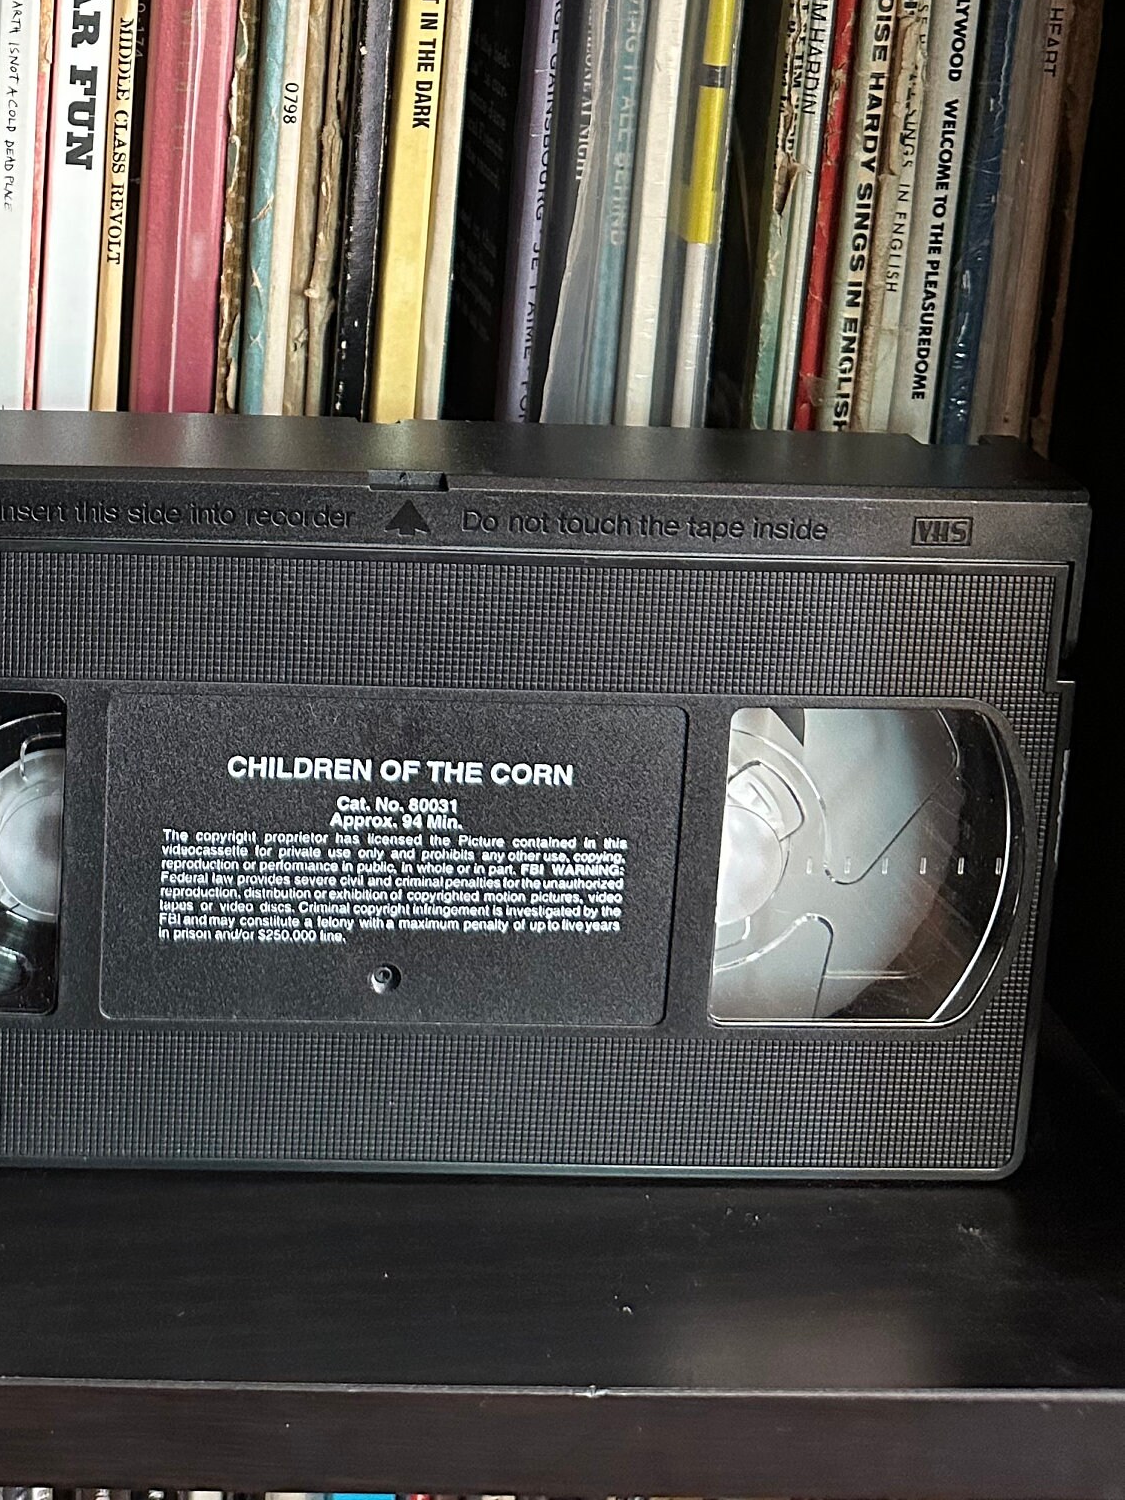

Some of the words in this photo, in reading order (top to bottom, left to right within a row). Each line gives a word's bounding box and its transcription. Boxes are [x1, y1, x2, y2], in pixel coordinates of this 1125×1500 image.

[420, 13, 439, 30] IN
[114, 18, 135, 100] MIDDLE
[417, 38, 436, 72] THE
[65, 65, 98, 170] FUN
[283, 83, 300, 124] 0798
[412, 80, 433, 128] DARK
[861, 72, 886, 172] HARDY
[110, 110, 129, 174] CLASS
[935, 100, 959, 191] WELCOME
[932, 195, 947, 218] TO
[107, 182, 125, 265] REVOLT
[849, 183, 873, 272] SINGS
[928, 222, 944, 255] THE
[846, 281, 863, 307] IN
[911, 260, 941, 400] PLEASUREDOME
[76, 503, 117, 524] this
[128, 503, 181, 525] side
[190, 503, 234, 525] into
[246, 504, 355, 528] recorder
[462, 510, 497, 532] Do
[507, 514, 546, 534] not
[556, 515, 630, 537] touch
[639, 515, 679, 538] the
[687, 517, 744, 542] tape
[752, 518, 827, 541] inside
[917, 520, 967, 542] VHS
[227, 756, 372, 782] CHILDREN
[380, 760, 421, 782] OF
[427, 760, 483, 784] THE
[491, 763, 574, 785] CORN
[330, 813, 398, 830] Approx.
[402, 814, 422, 829] 94
[427, 815, 462, 830] Min.
[336, 797, 371, 813] Cat.
[375, 798, 403, 813] No.
[409, 798, 458, 813] 80031
[521, 864, 544, 876] FBI
